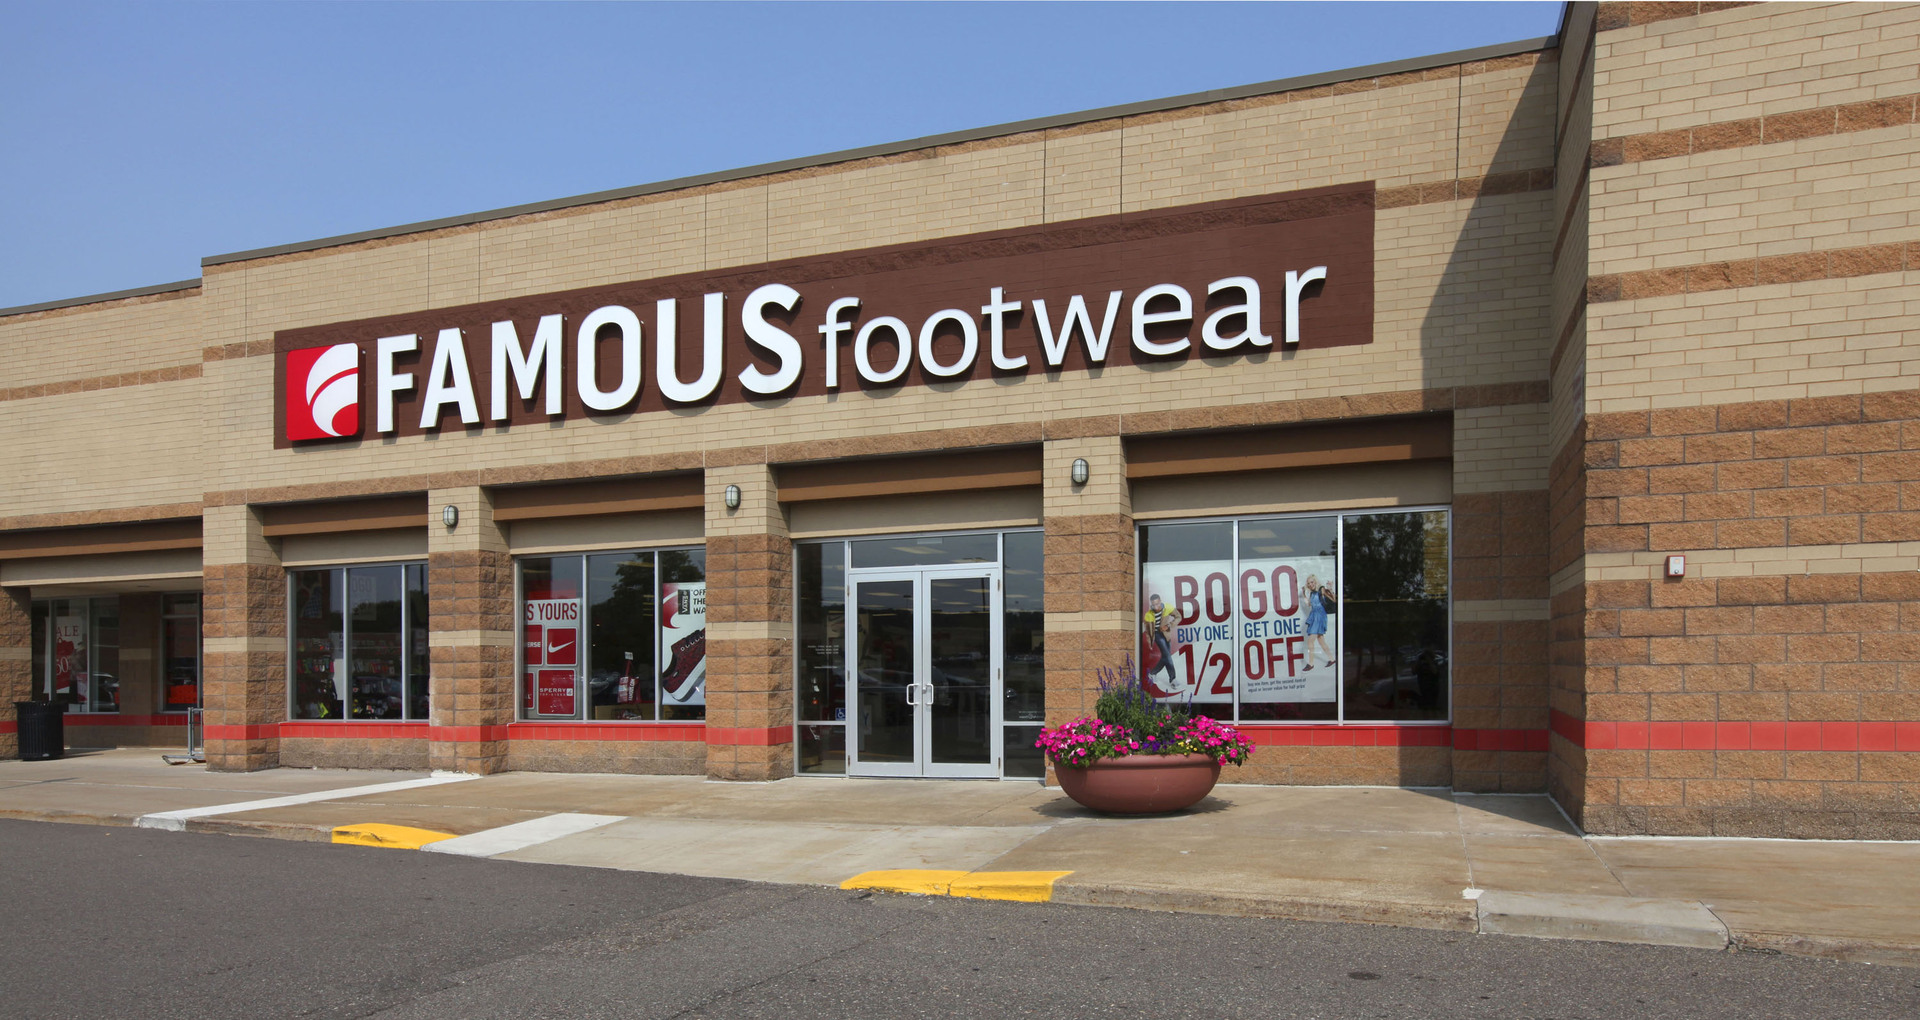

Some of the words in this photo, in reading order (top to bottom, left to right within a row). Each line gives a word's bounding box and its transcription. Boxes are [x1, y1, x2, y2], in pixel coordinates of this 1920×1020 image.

[377, 283, 803, 432] FAMOUS
[818, 265, 1328, 388] footwear
[538, 602, 577, 620] YOURS
[1174, 565, 1299, 626] BOGO
[56, 625, 80, 637] ALE
[1177, 626, 1201, 643] BUY
[1244, 620, 1270, 638] GET
[1274, 618, 1301, 636] ONE
[1178, 642, 1233, 696] 1/2
[1243, 636, 1305, 680] OFF
